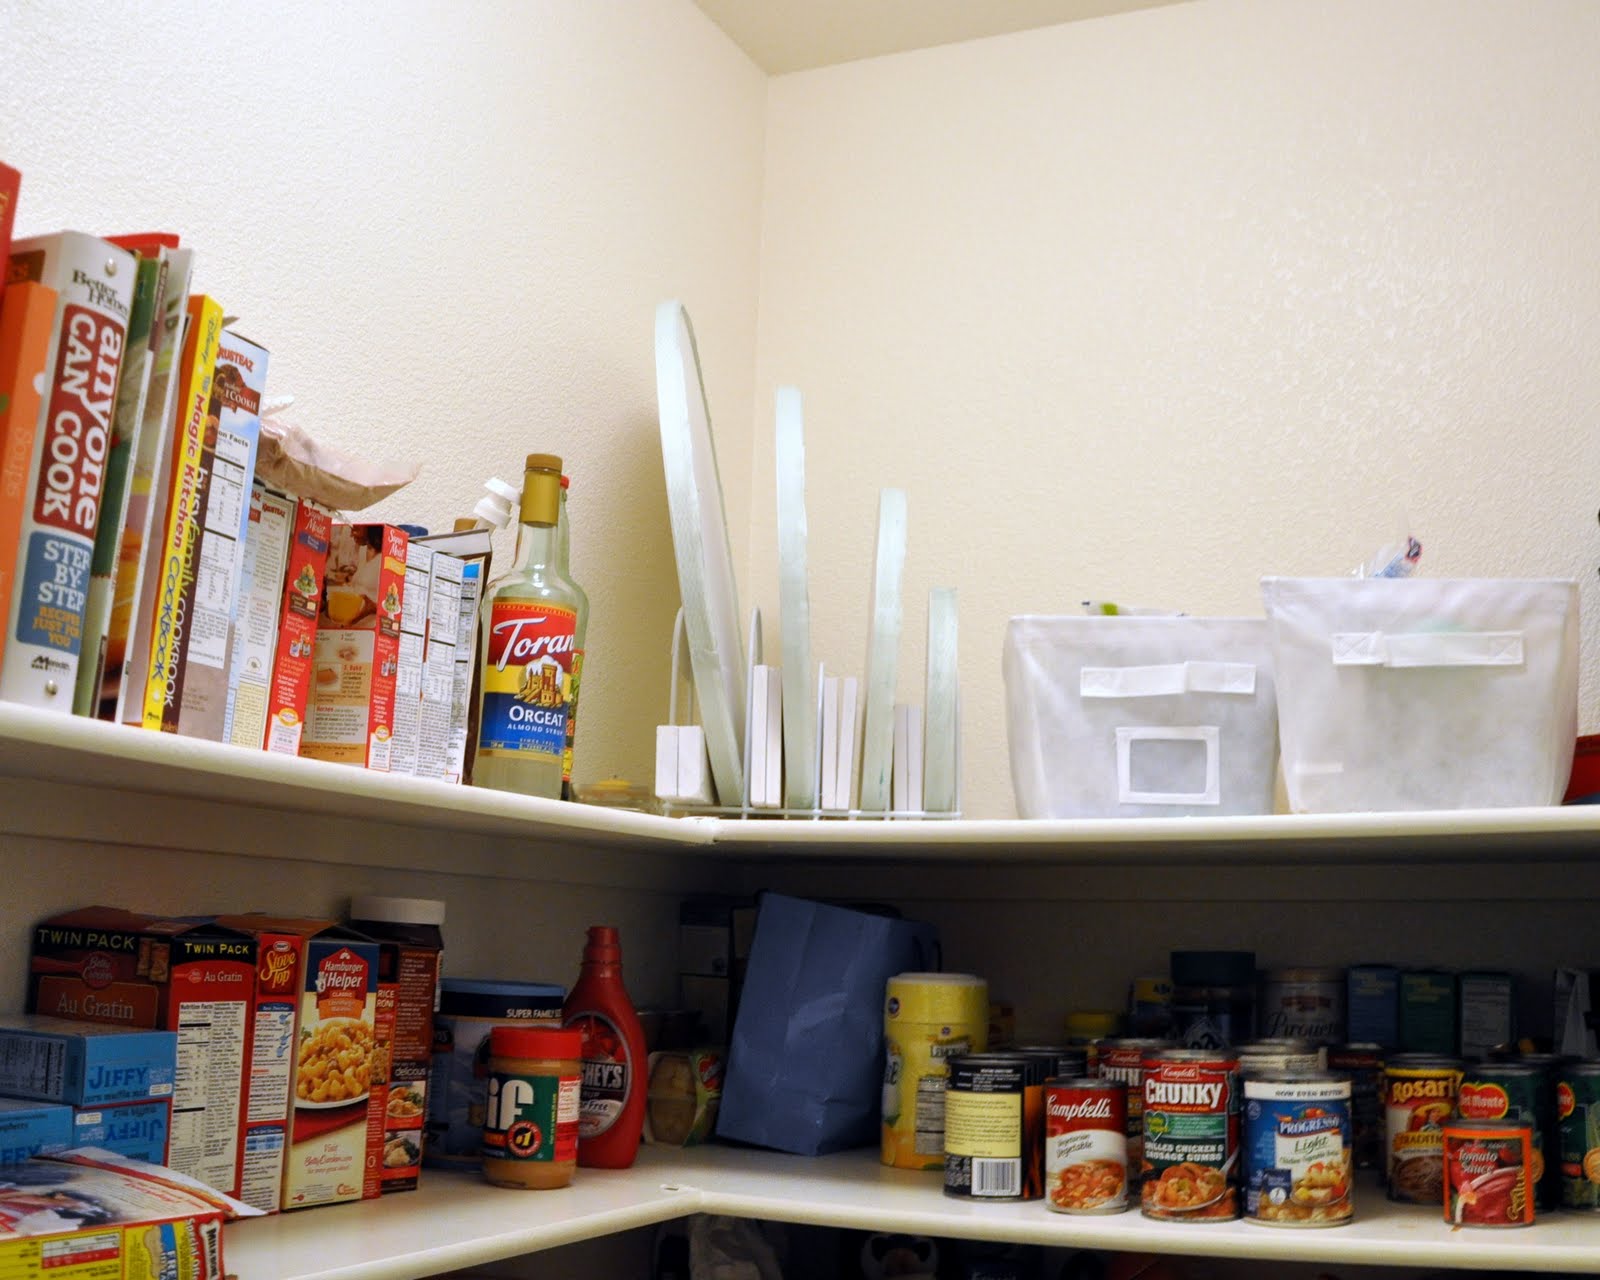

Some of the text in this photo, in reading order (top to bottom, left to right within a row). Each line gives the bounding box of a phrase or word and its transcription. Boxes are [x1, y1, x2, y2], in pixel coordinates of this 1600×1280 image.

[72, 268, 118, 297] Better
[42, 313, 96, 520] CAN COOK
[75, 325, 122, 530] anyone
[174, 393, 206, 549] Magic Kitchen
[508, 705, 564, 727] ORGEAT
[507, 723, 543, 733] ALMOND
[38, 929, 135, 950] TWIN PACK
[184, 942, 249, 955] TWIN PACK
[260, 950, 297, 981] Stove
[324, 960, 364, 974] Hamburger
[203, 970, 243, 982] Au Gratin
[271, 969, 291, 989] Top
[326, 971, 363, 990] Helper
[377, 989, 395, 999] RICE
[56, 992, 135, 1019] Au Gratin
[506, 1008, 532, 1018] SUPER
[88, 1066, 149, 1089] JIFFY
[581, 1063, 622, 1089] HEY'S
[1145, 1078, 1223, 1109] CHUNKY
[1472, 1095, 1505, 1108] Monte
[1047, 1094, 1111, 1122] Campbell's
[104, 1119, 164, 1141] JIFFY
[515, 1131, 532, 1147] #1
[1056, 1141, 1093, 1159] Vegetable
[1175, 1144, 1216, 1153] CHICKEN
[1295, 1135, 1329, 1155] Light
[1459, 1148, 1498, 1162] Tomato
[1462, 1162, 1494, 1174] Sauce
